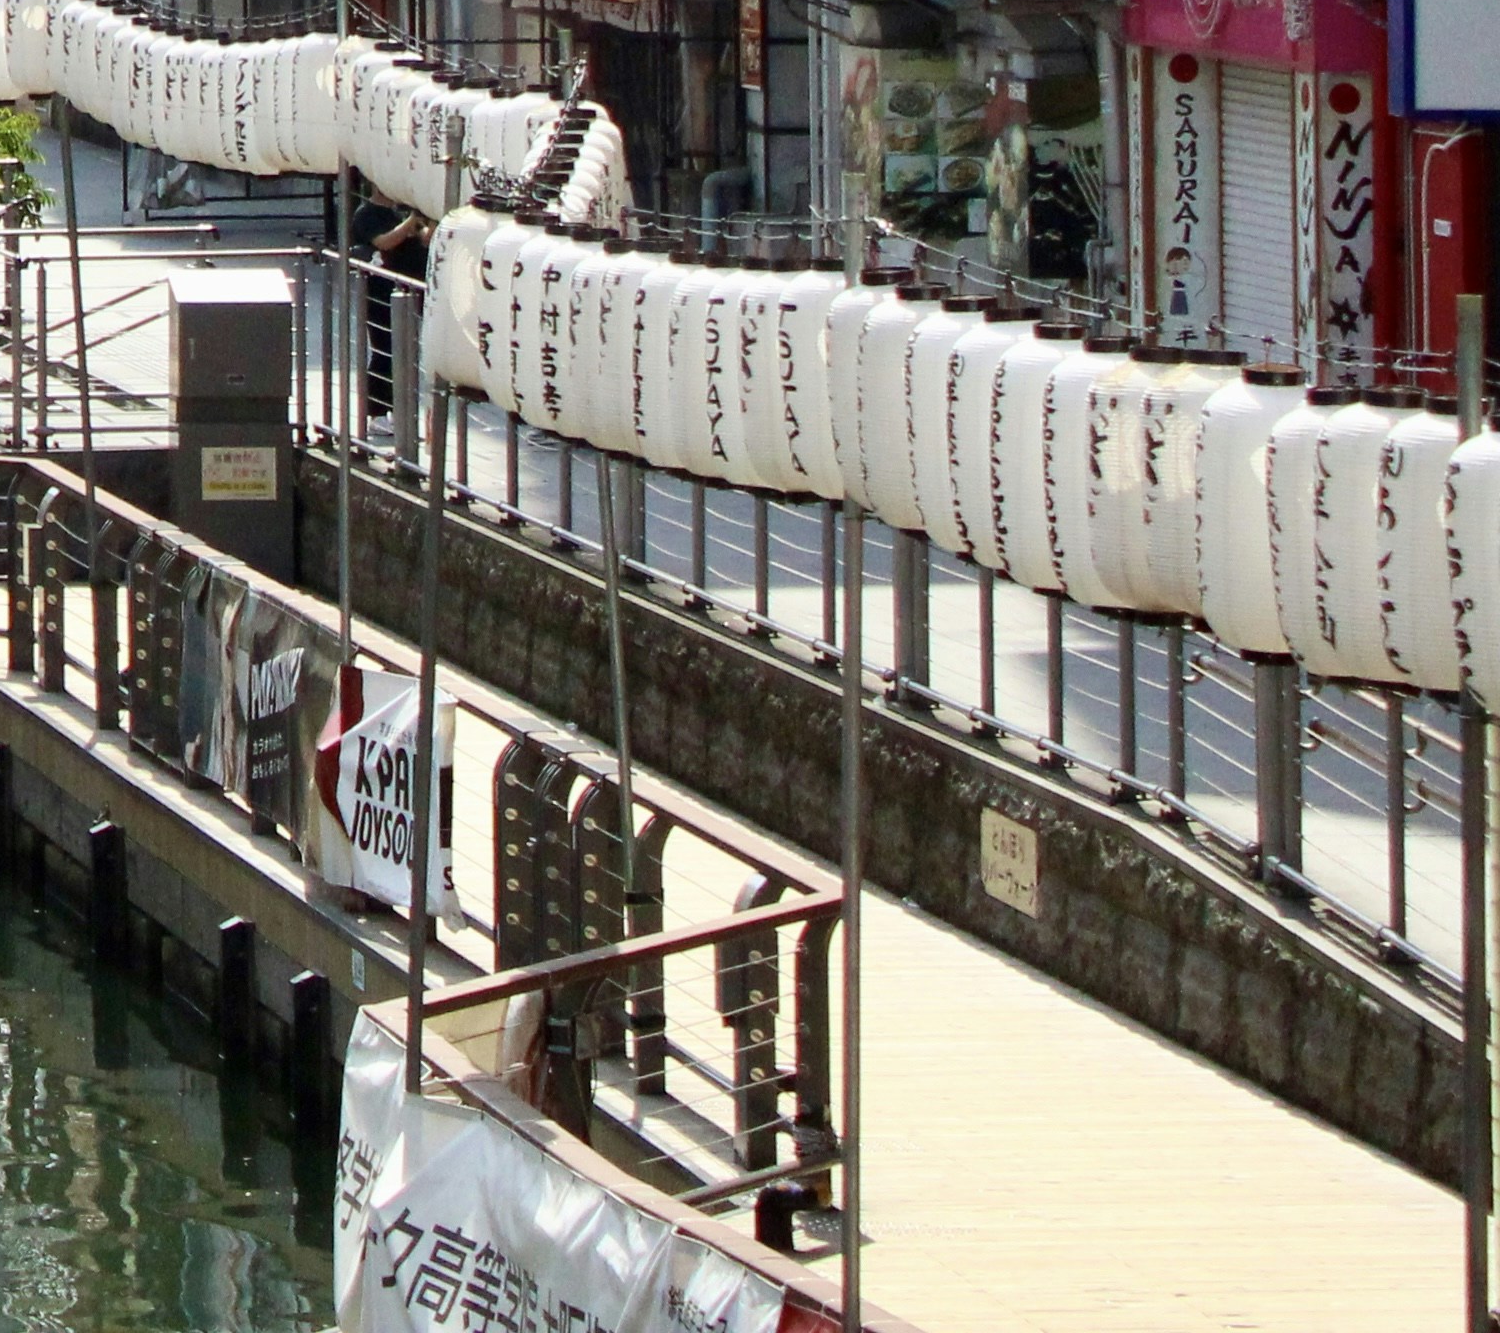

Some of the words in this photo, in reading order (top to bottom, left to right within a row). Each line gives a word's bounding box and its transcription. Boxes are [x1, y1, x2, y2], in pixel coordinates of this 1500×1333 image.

[1173, 93, 1199, 244] SAMURAI
[1324, 120, 1373, 274] NINJA
[354, 735, 418, 811] KPA
